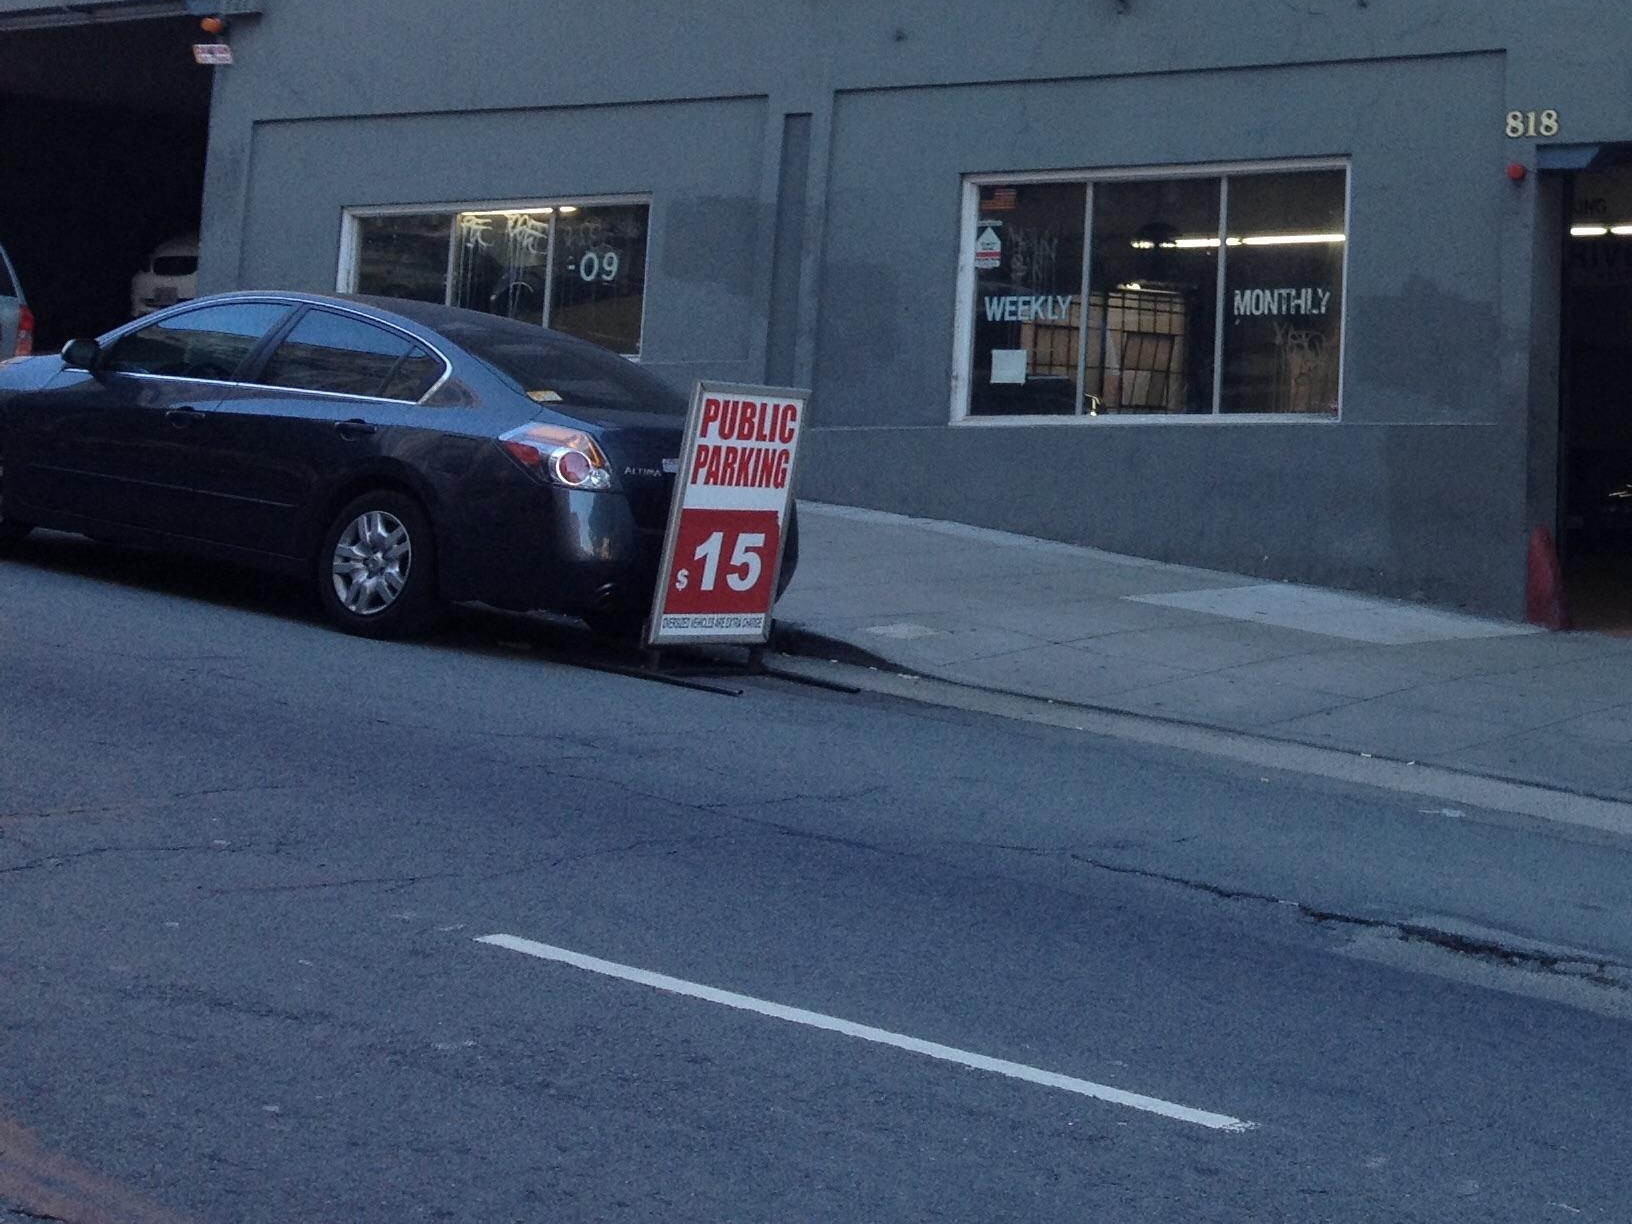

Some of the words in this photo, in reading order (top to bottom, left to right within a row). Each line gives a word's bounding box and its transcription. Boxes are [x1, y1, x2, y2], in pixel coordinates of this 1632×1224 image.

[1505, 109, 1560, 139] 818
[984, 294, 1073, 323] WEEKLY
[1233, 287, 1331, 316] MONTHLY
[699, 398, 798, 444] PUBLIC
[623, 466, 662, 477] ALTIMA
[690, 444, 790, 489] PARKING
